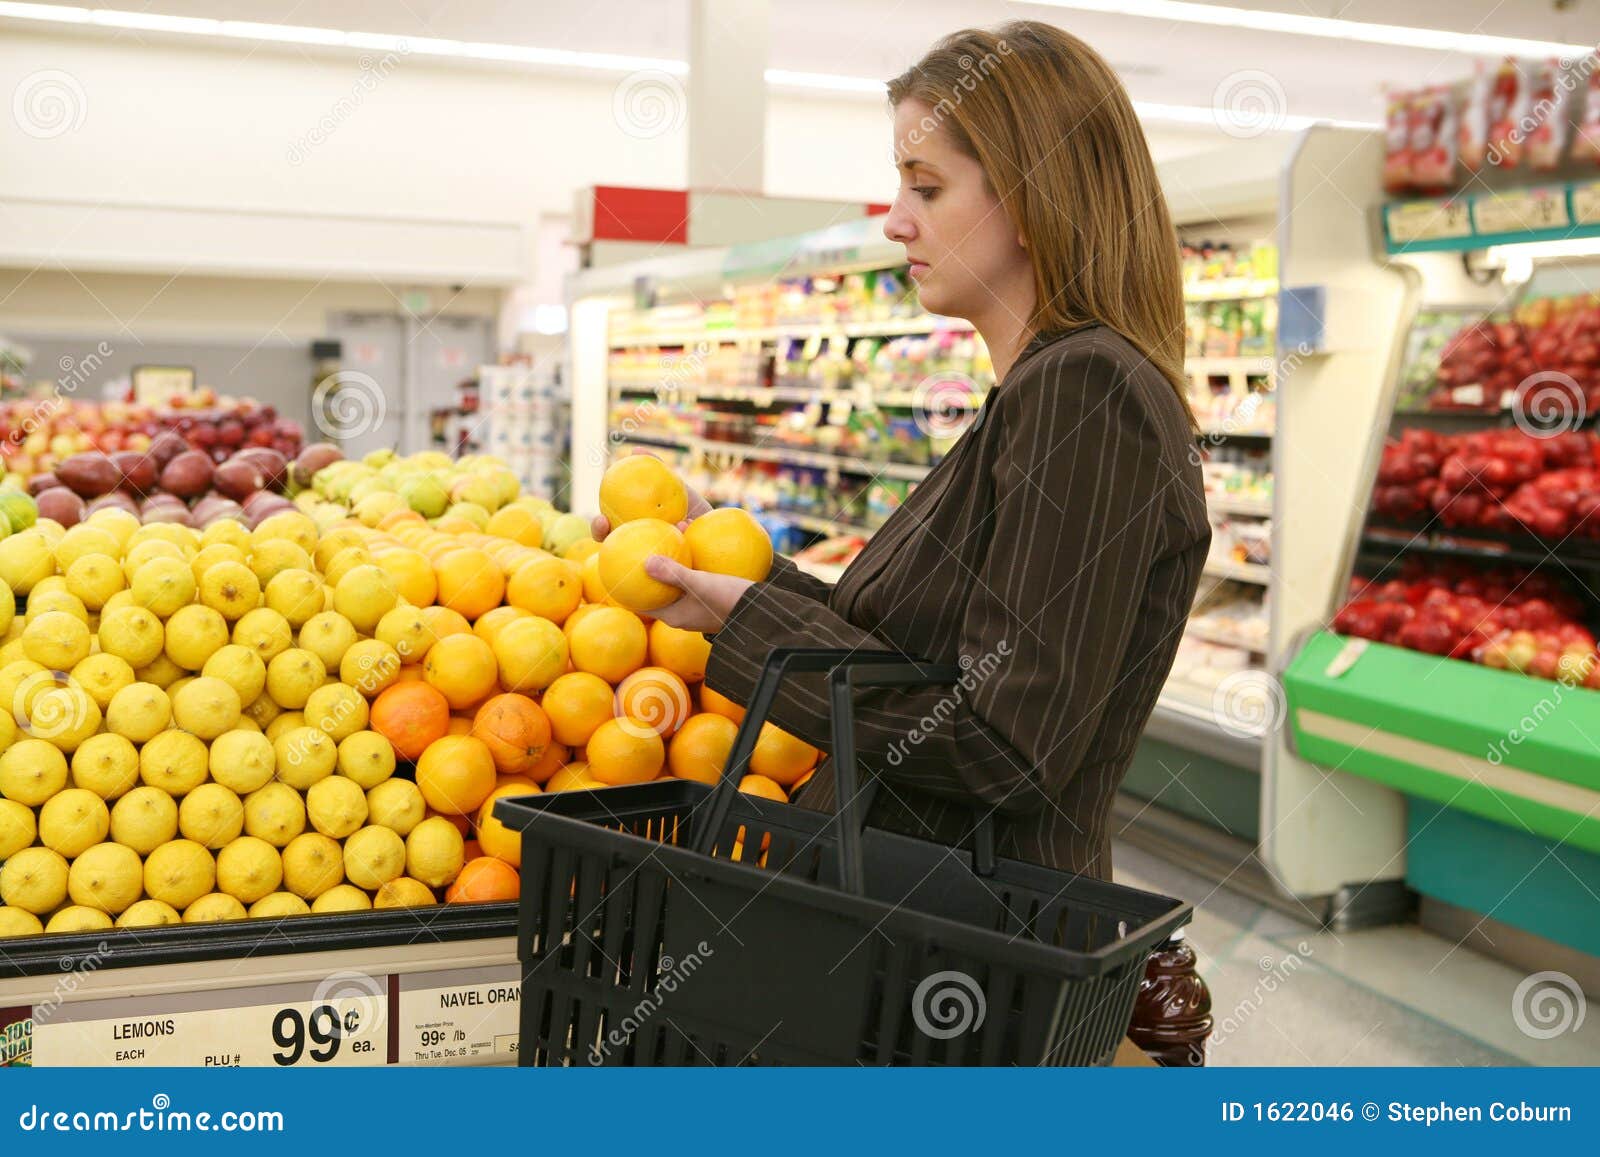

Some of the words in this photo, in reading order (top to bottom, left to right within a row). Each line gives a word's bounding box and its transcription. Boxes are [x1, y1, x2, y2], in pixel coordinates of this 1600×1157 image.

[440, 991, 484, 1008] NAVEL
[113, 1019, 175, 1040] LEMONS
[453, 1030, 466, 1042] /lb
[352, 1040, 376, 1053] ea.
[115, 1049, 145, 1061] EACH
[205, 1055, 230, 1066] PLU
[234, 1054, 241, 1064] #
[415, 1051, 429, 1060] Thru
